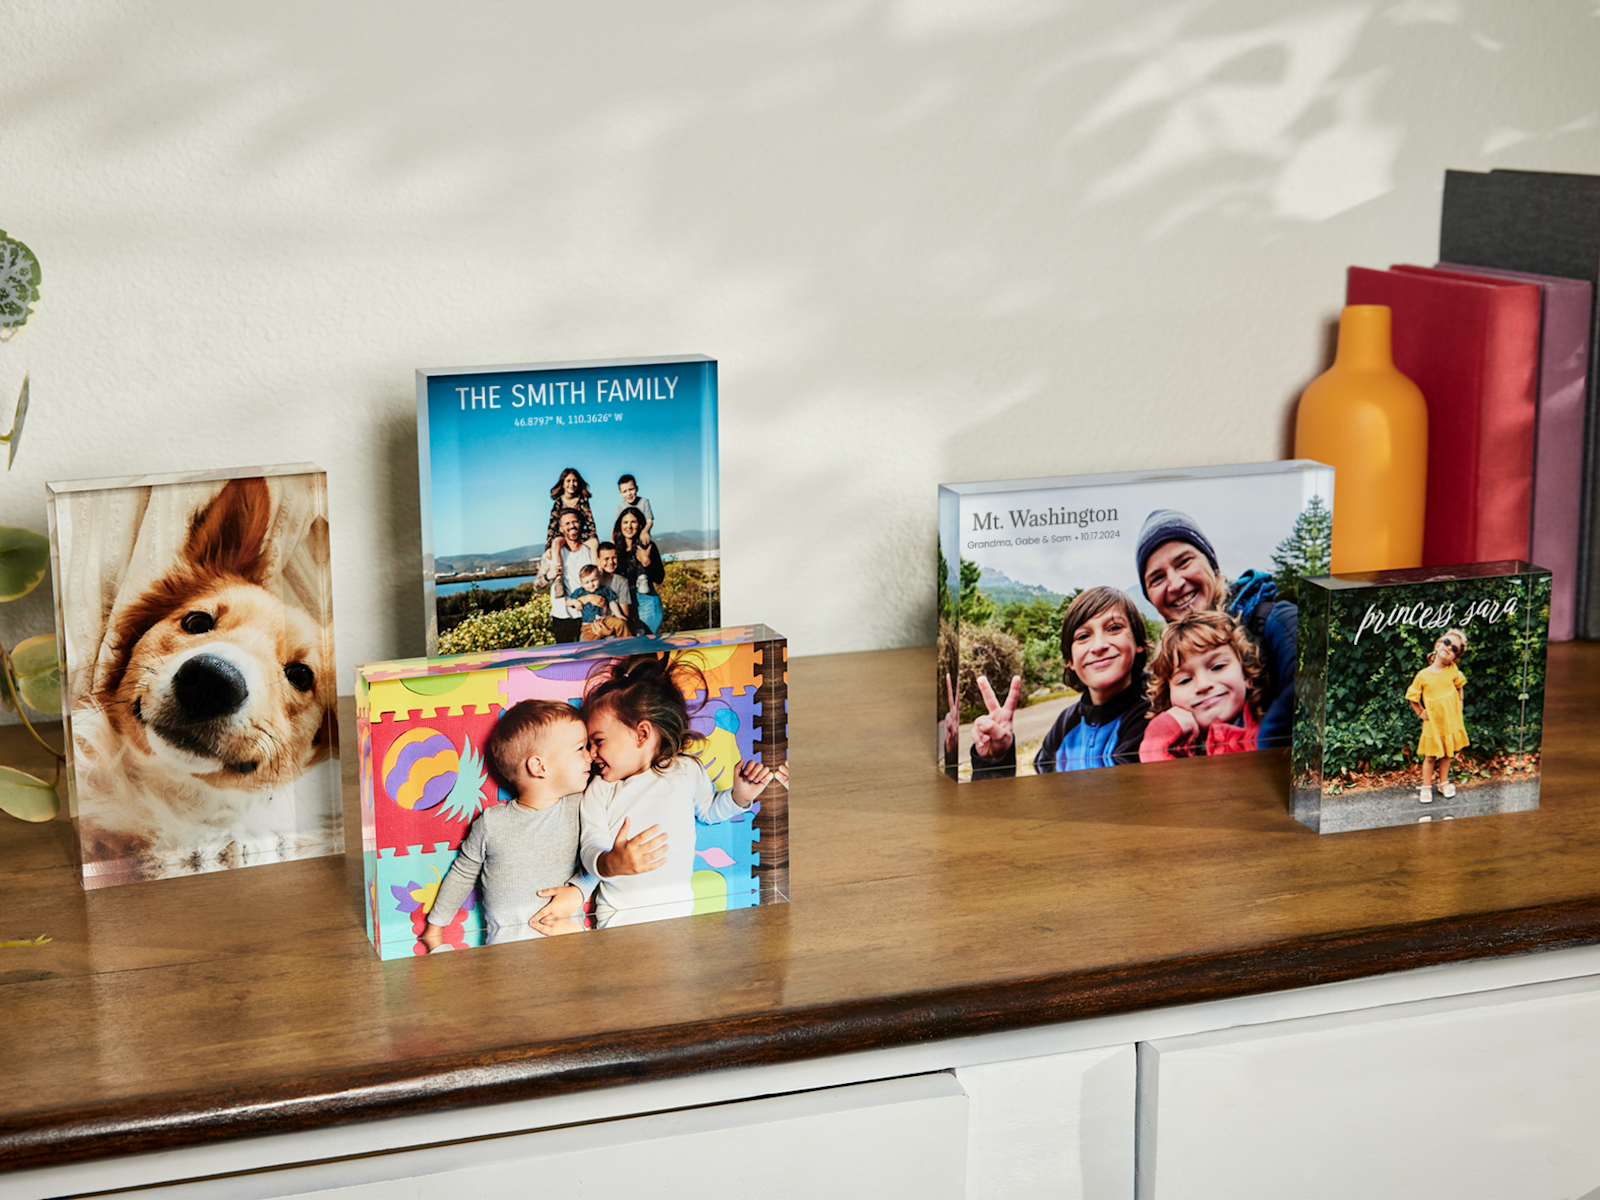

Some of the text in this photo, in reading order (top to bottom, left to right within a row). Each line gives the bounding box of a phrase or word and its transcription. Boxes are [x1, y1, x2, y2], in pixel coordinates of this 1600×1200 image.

[455, 376, 679, 410] THE SMITH FAMILY
[614, 412, 623, 422] W
[972, 507, 1119, 531] Mt. Washington
[967, 530, 1120, 549] Grandma, Gabe & Sam 10.17.2024
[1353, 597, 1518, 646] princess sara
